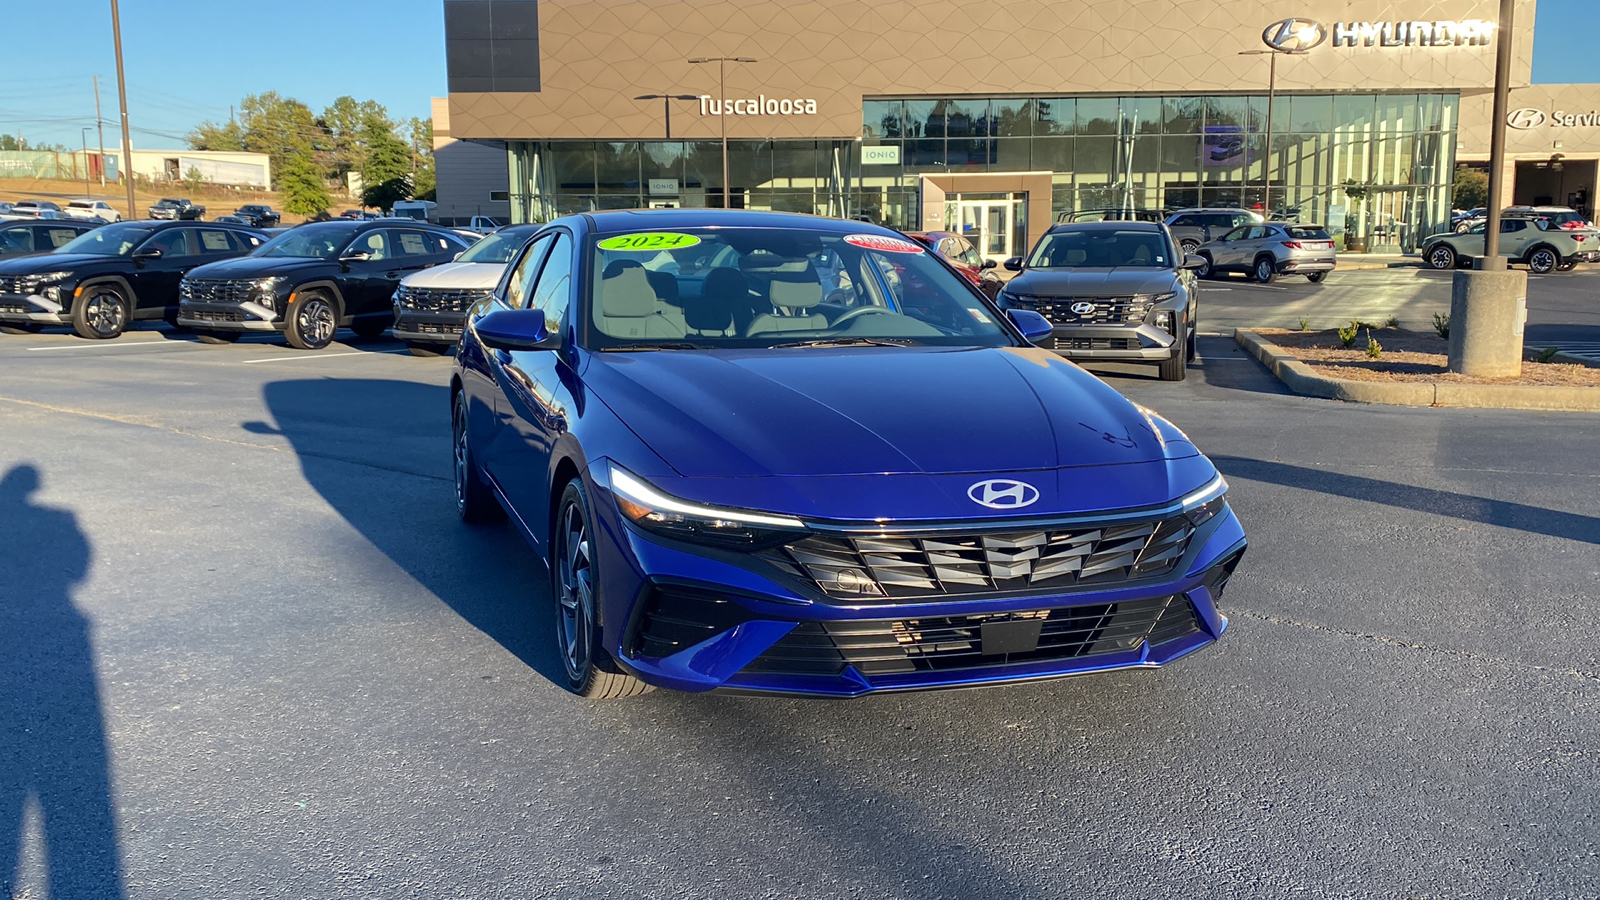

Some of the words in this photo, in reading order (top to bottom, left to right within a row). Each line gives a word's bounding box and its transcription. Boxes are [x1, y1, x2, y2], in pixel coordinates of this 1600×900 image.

[1332, 20, 1496, 47] HYUNDAI
[699, 94, 818, 116] Tuscaloosa
[865, 150, 896, 159] IONIQ
[612, 234, 684, 249] 2024
